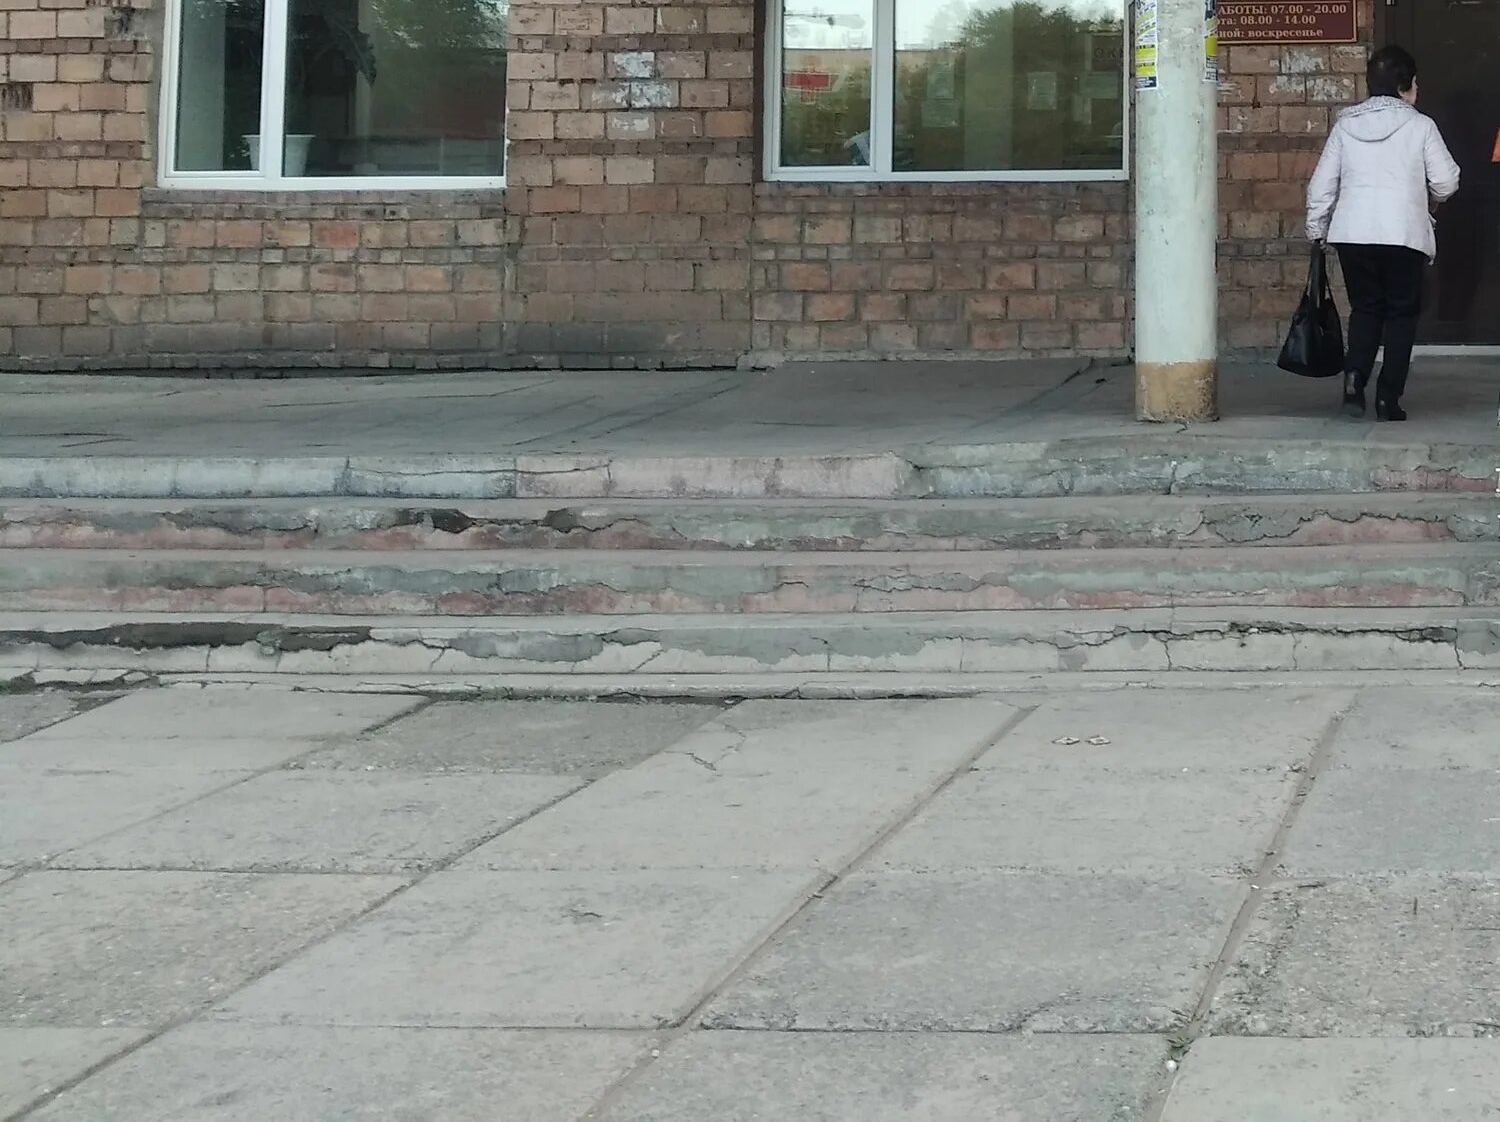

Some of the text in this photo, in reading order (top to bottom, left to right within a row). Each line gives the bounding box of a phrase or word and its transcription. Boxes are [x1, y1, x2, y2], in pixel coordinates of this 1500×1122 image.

[1218, 5, 1268, 15] АБОТЫ:
[1270, 4, 1303, 15] 07.00
[1314, 4, 1347, 14] 20.00
[1240, 15, 1273, 26] 08.00
[1284, 14, 1316, 25] 14.00
[1248, 28, 1323, 39] воскресенье
